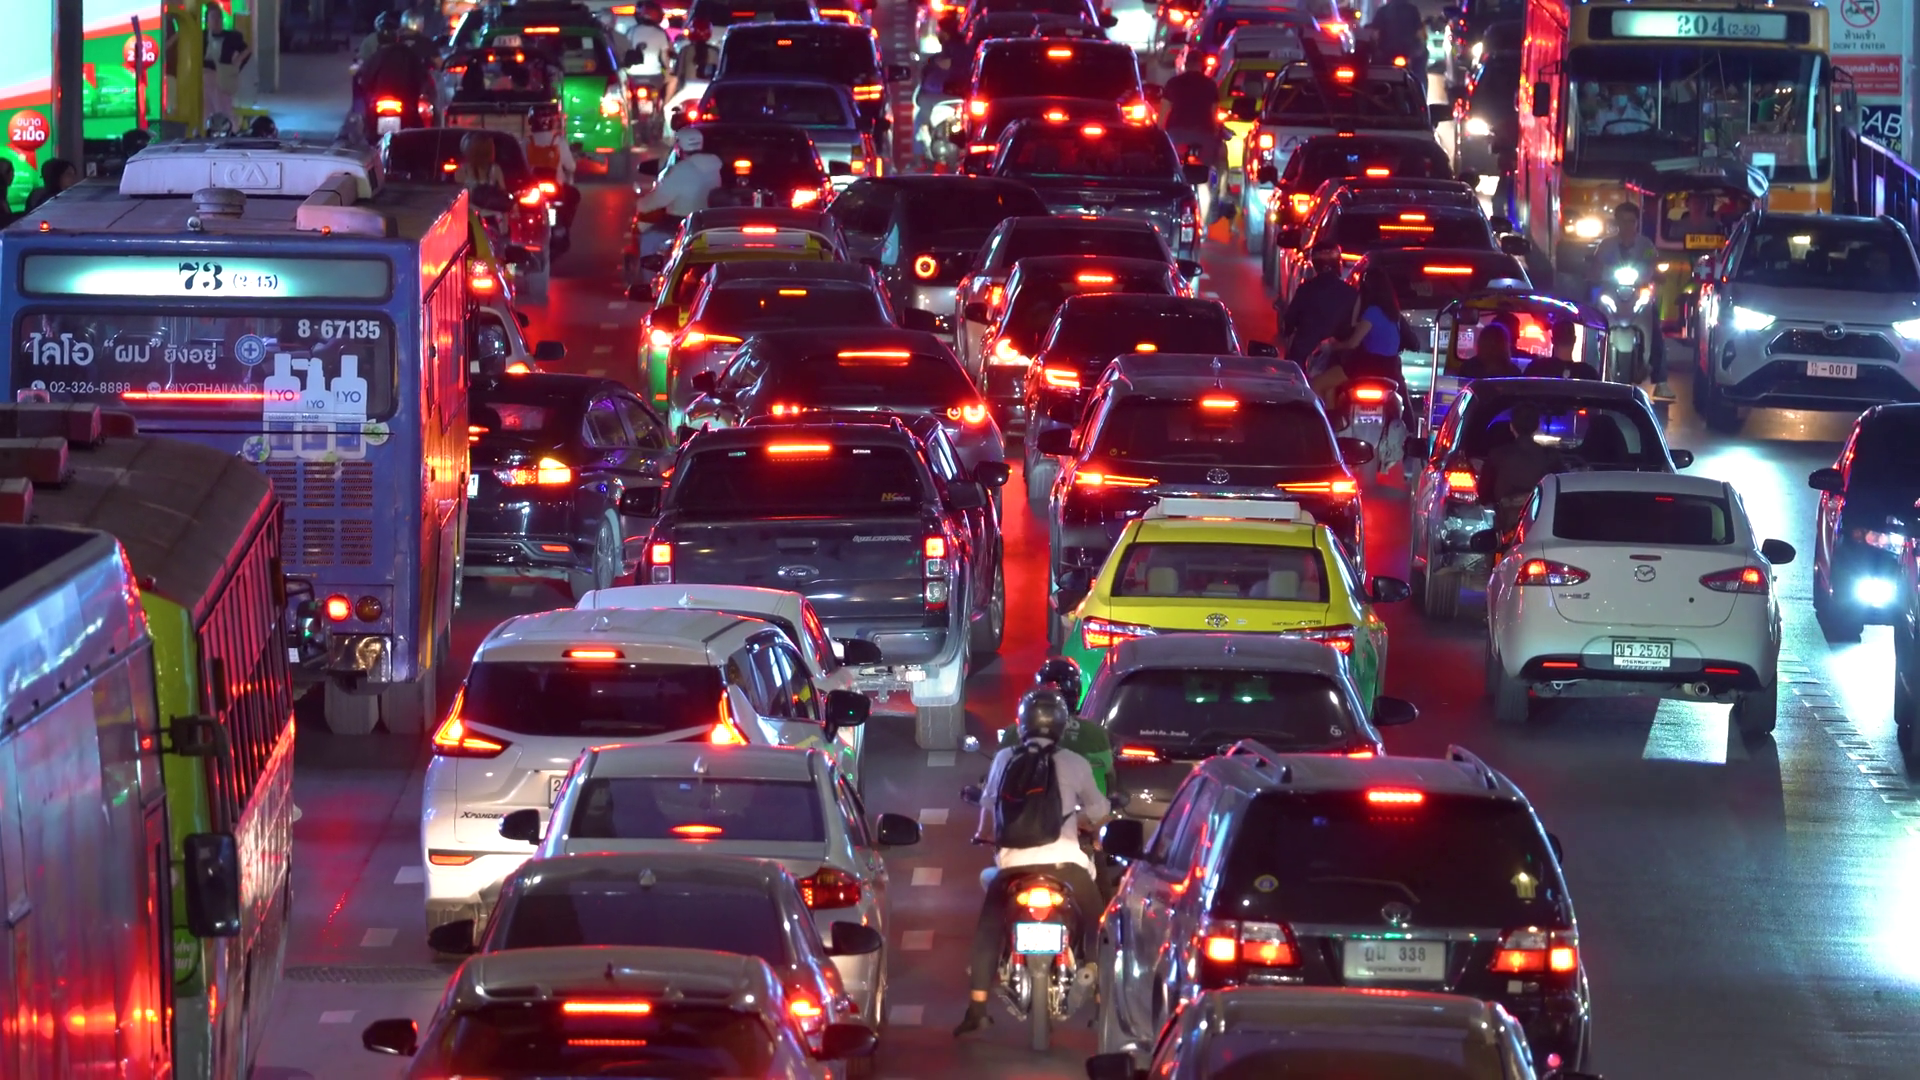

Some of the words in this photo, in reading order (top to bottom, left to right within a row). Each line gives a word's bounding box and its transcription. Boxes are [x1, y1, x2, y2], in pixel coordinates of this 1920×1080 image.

[1677, 15, 1725, 35] 204
[1727, 24, 1761, 36] (2-52)
[1860, 42, 1886, 51] ENTER
[178, 261, 223, 291] 73
[30, 332, 94, 366] ไลโอ
[163, 342, 217, 370] ยังอยู่
[49, 381, 131, 394] 02-326-8888
[1639, 644, 1669, 658] 2573
[460, 811, 505, 819] XPANDE
